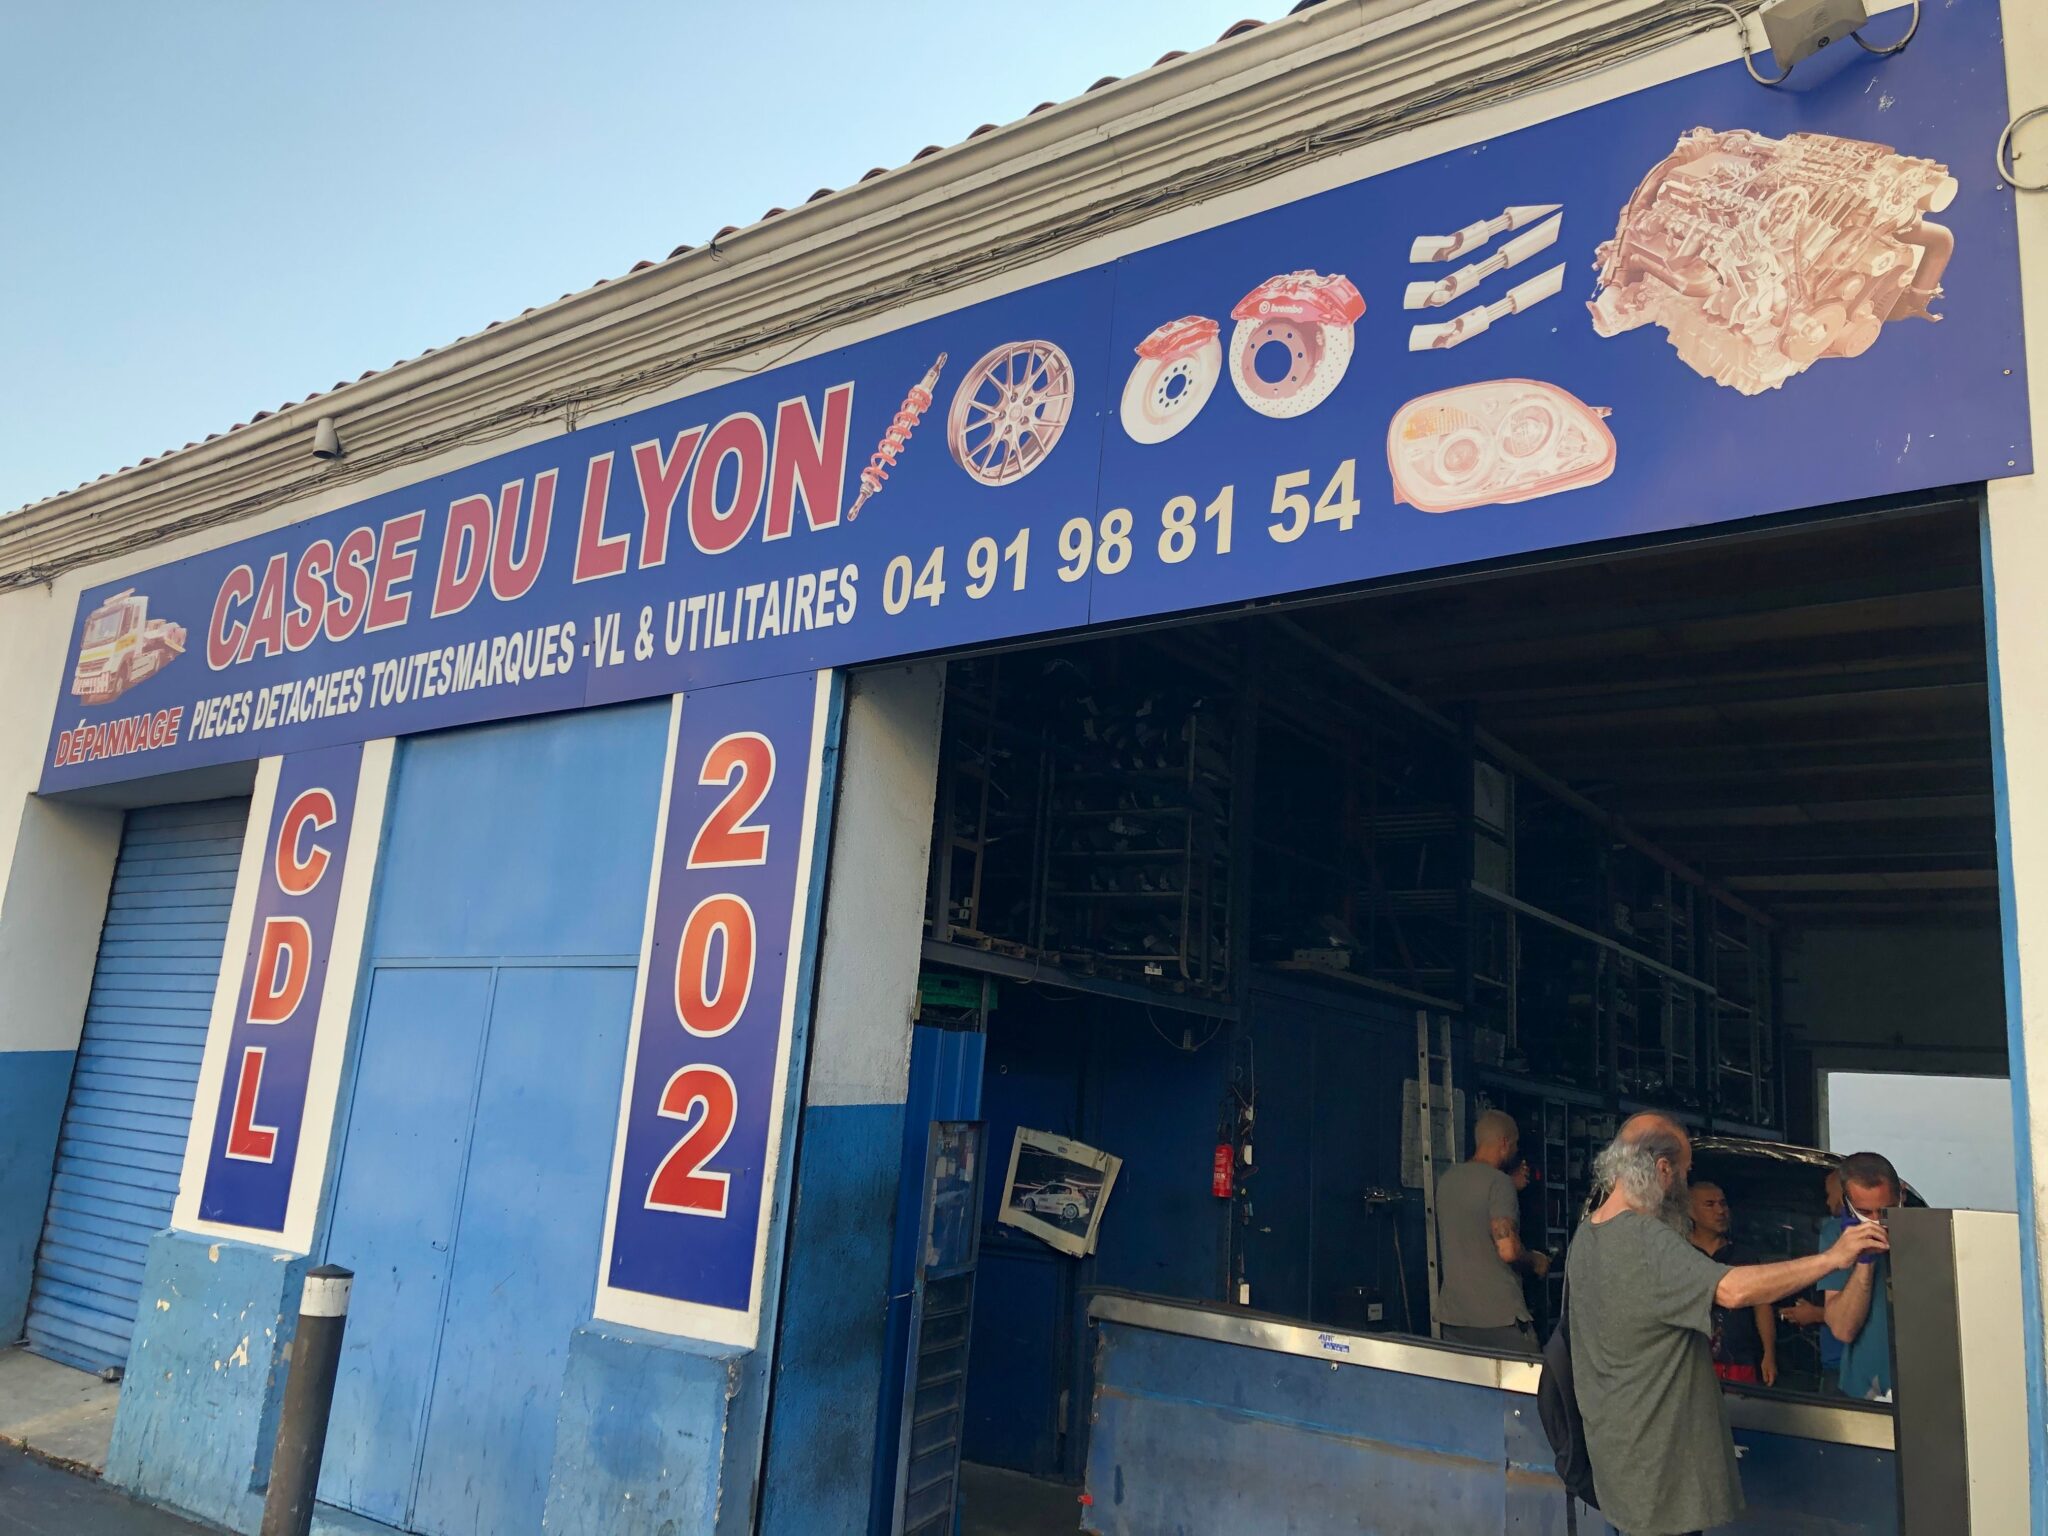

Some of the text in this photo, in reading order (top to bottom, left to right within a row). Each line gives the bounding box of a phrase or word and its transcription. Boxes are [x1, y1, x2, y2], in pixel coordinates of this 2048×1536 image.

[206, 380, 855, 671] CASSE DU LYON
[882, 458, 1361, 616] 04 91 98 81 54
[188, 689, 254, 741] PIECES
[252, 666, 366, 730] DETACHEES
[634, 605, 655, 661] &
[664, 563, 859, 655] UTILITAIRES
[54, 706, 185, 767] DÉPANNAGE
